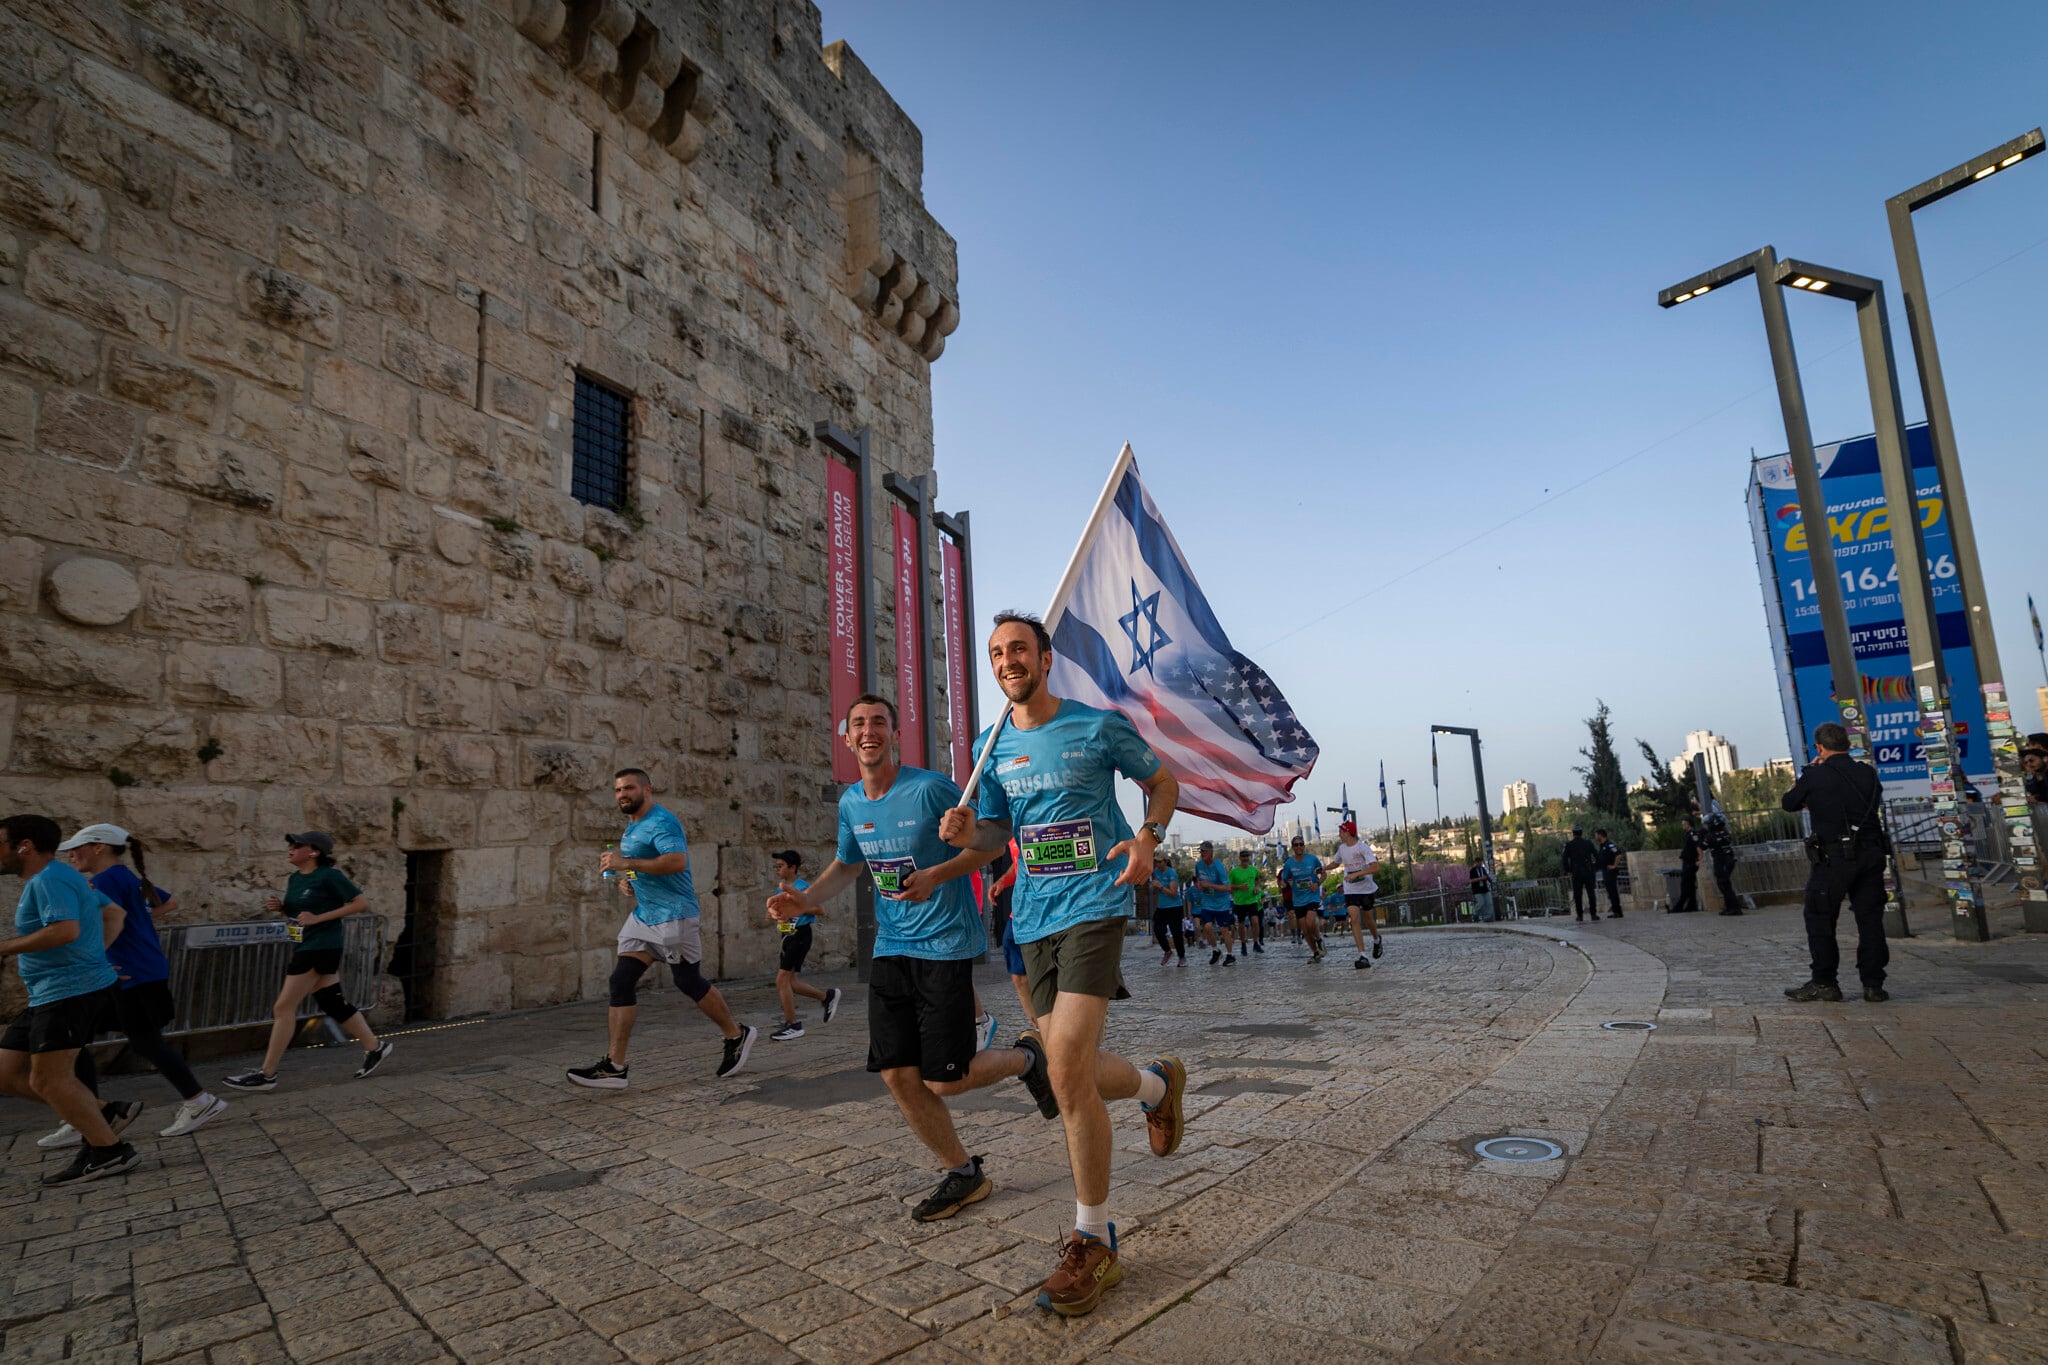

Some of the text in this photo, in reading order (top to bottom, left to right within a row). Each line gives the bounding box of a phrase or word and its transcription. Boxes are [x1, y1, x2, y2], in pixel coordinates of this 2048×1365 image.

[1826, 496, 1887, 514] Jerusale
[834, 490, 845, 638] TOWER of DAVID
[843, 496, 857, 677] JERUSALEM MUSEUM
[901, 537, 916, 722] برج داود متحف القدس
[949, 567, 957, 602] מגדל
[956, 690, 965, 746] ירושלים
[1870, 727, 1908, 742] ירוש
[1879, 746, 1902, 762] 04
[1026, 843, 1073, 860] A 14292
[1093, 1256, 1110, 1282] HOKA
